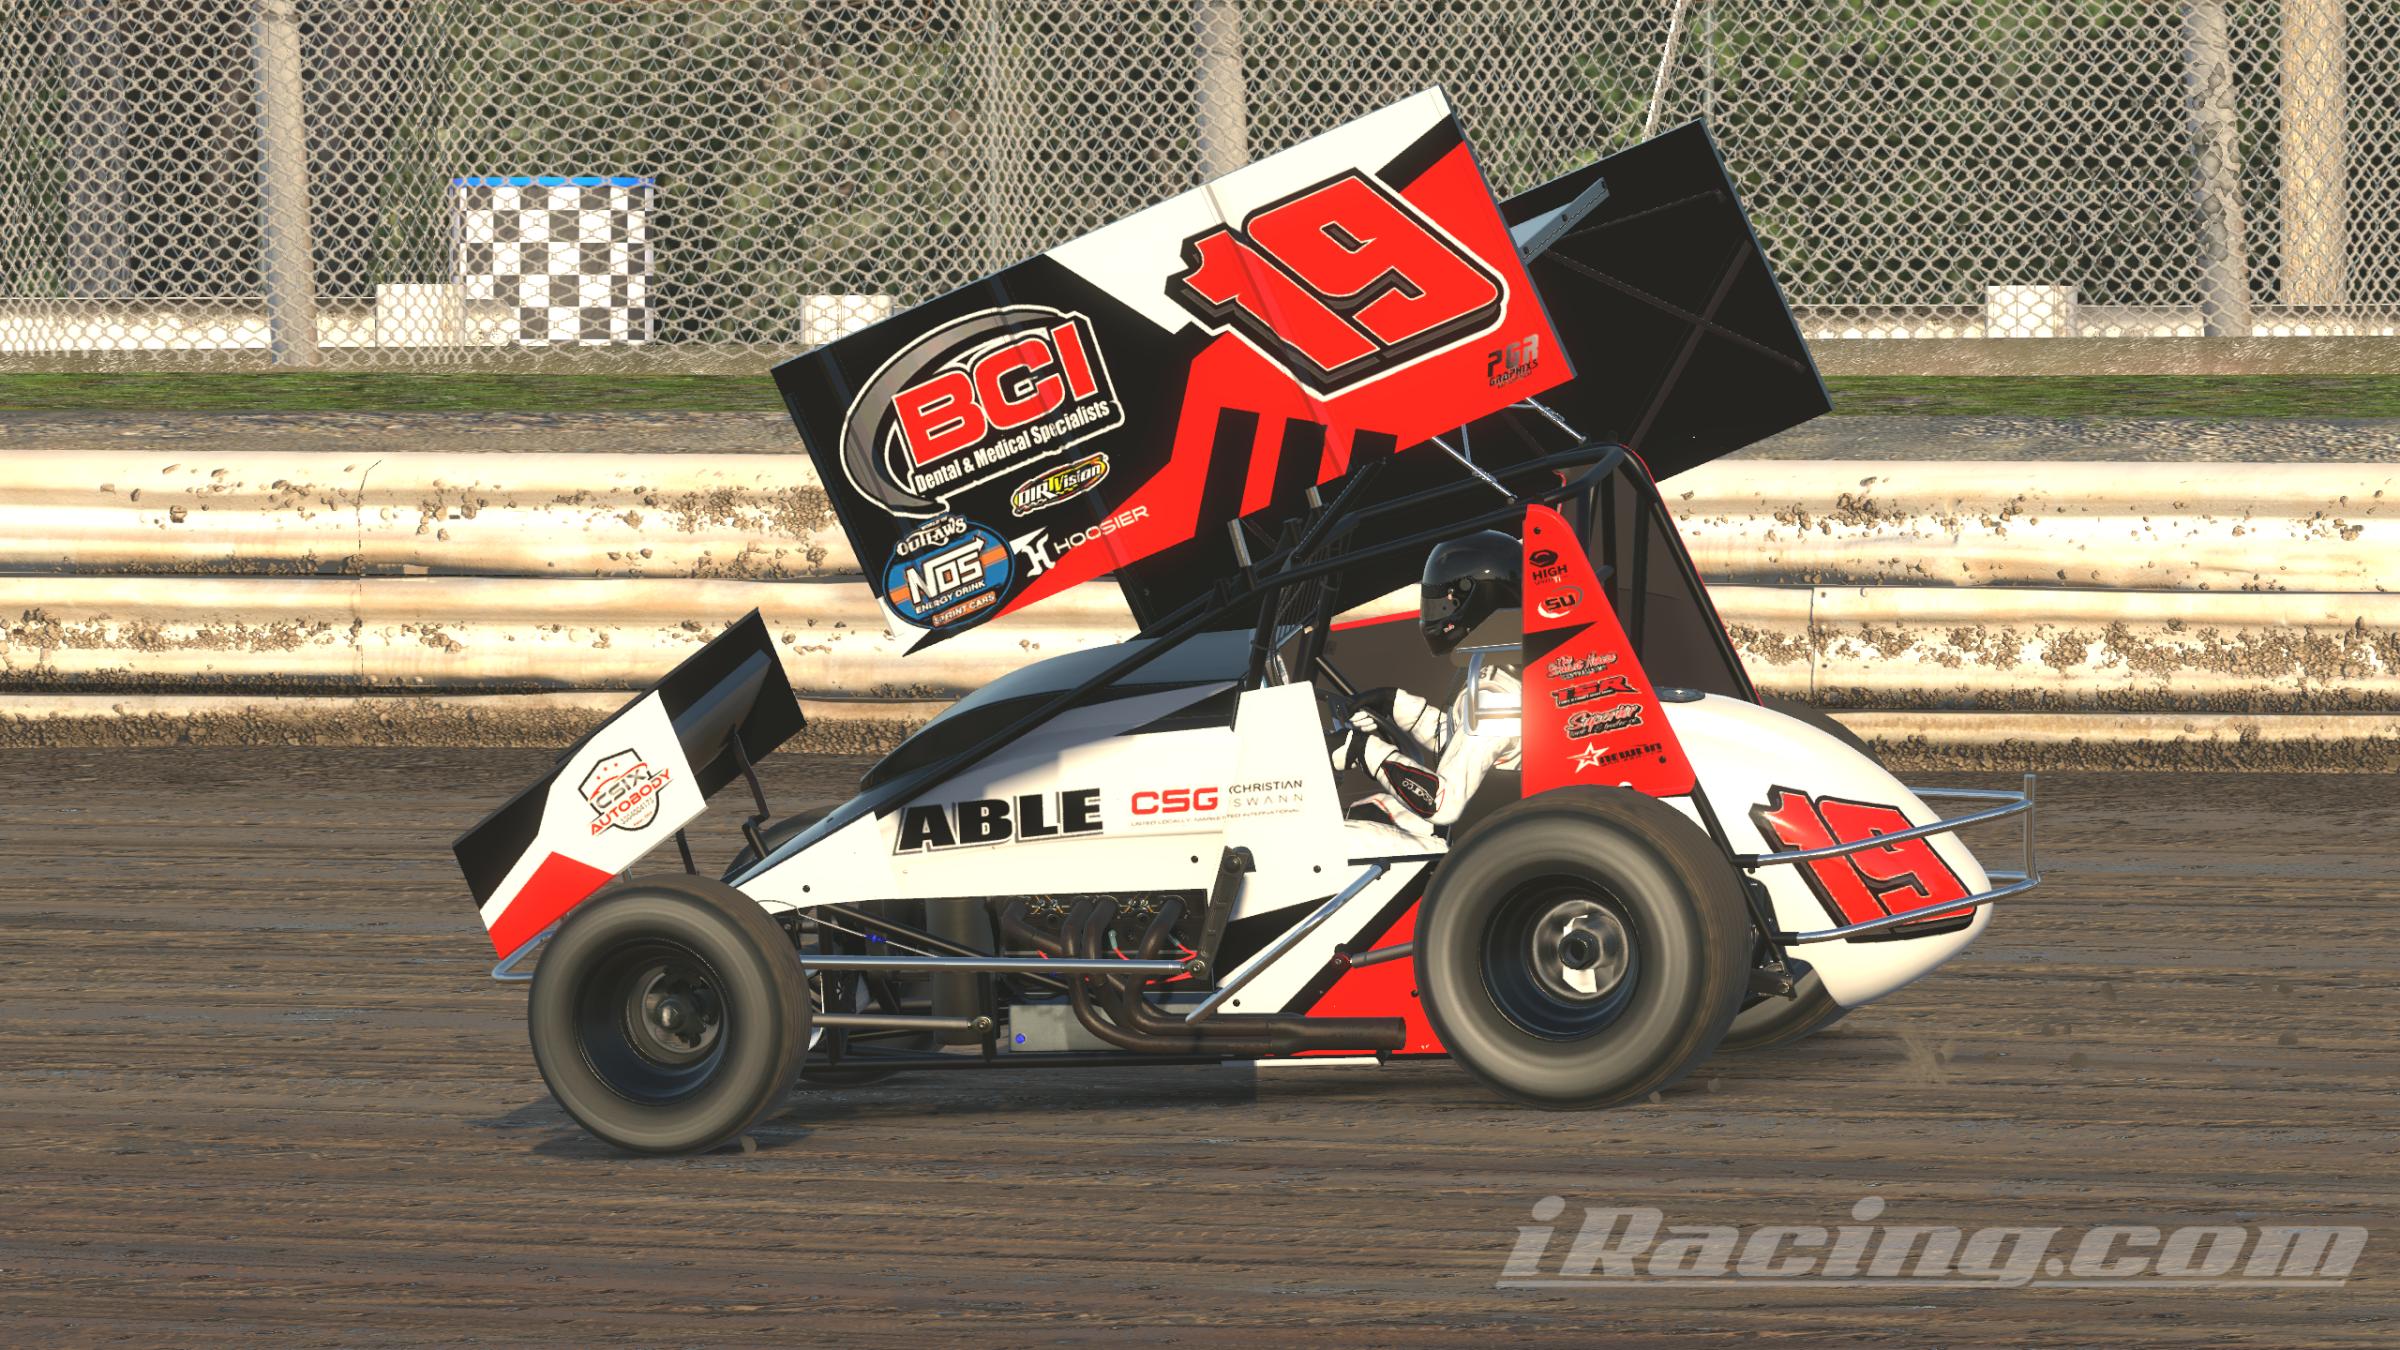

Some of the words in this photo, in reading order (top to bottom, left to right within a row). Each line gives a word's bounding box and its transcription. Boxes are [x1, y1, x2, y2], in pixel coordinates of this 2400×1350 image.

[1164, 167, 1508, 397] 19
[892, 321, 1098, 467] BCI
[915, 460, 962, 493] Dental
[963, 457, 975, 473] &
[974, 430, 1031, 468] Medical
[1031, 401, 1110, 444] Specialists
[897, 517, 967, 556] OUTLAWS
[1054, 506, 1149, 554] HOOSIER
[906, 536, 985, 604] NOS
[1532, 565, 1567, 580] HIGH
[915, 593, 953, 614] ENERGY
[955, 580, 986, 598] DRINK
[1545, 594, 1576, 610] SU
[1552, 675, 1641, 703] TSR
[591, 769, 670, 835] AUTOBODY
[596, 769, 647, 808] CSIX
[1233, 794, 1303, 807] SWANN
[893, 787, 1103, 856] ABLE
[1132, 787, 1218, 815] CSG
[1749, 785, 1977, 943] 19
